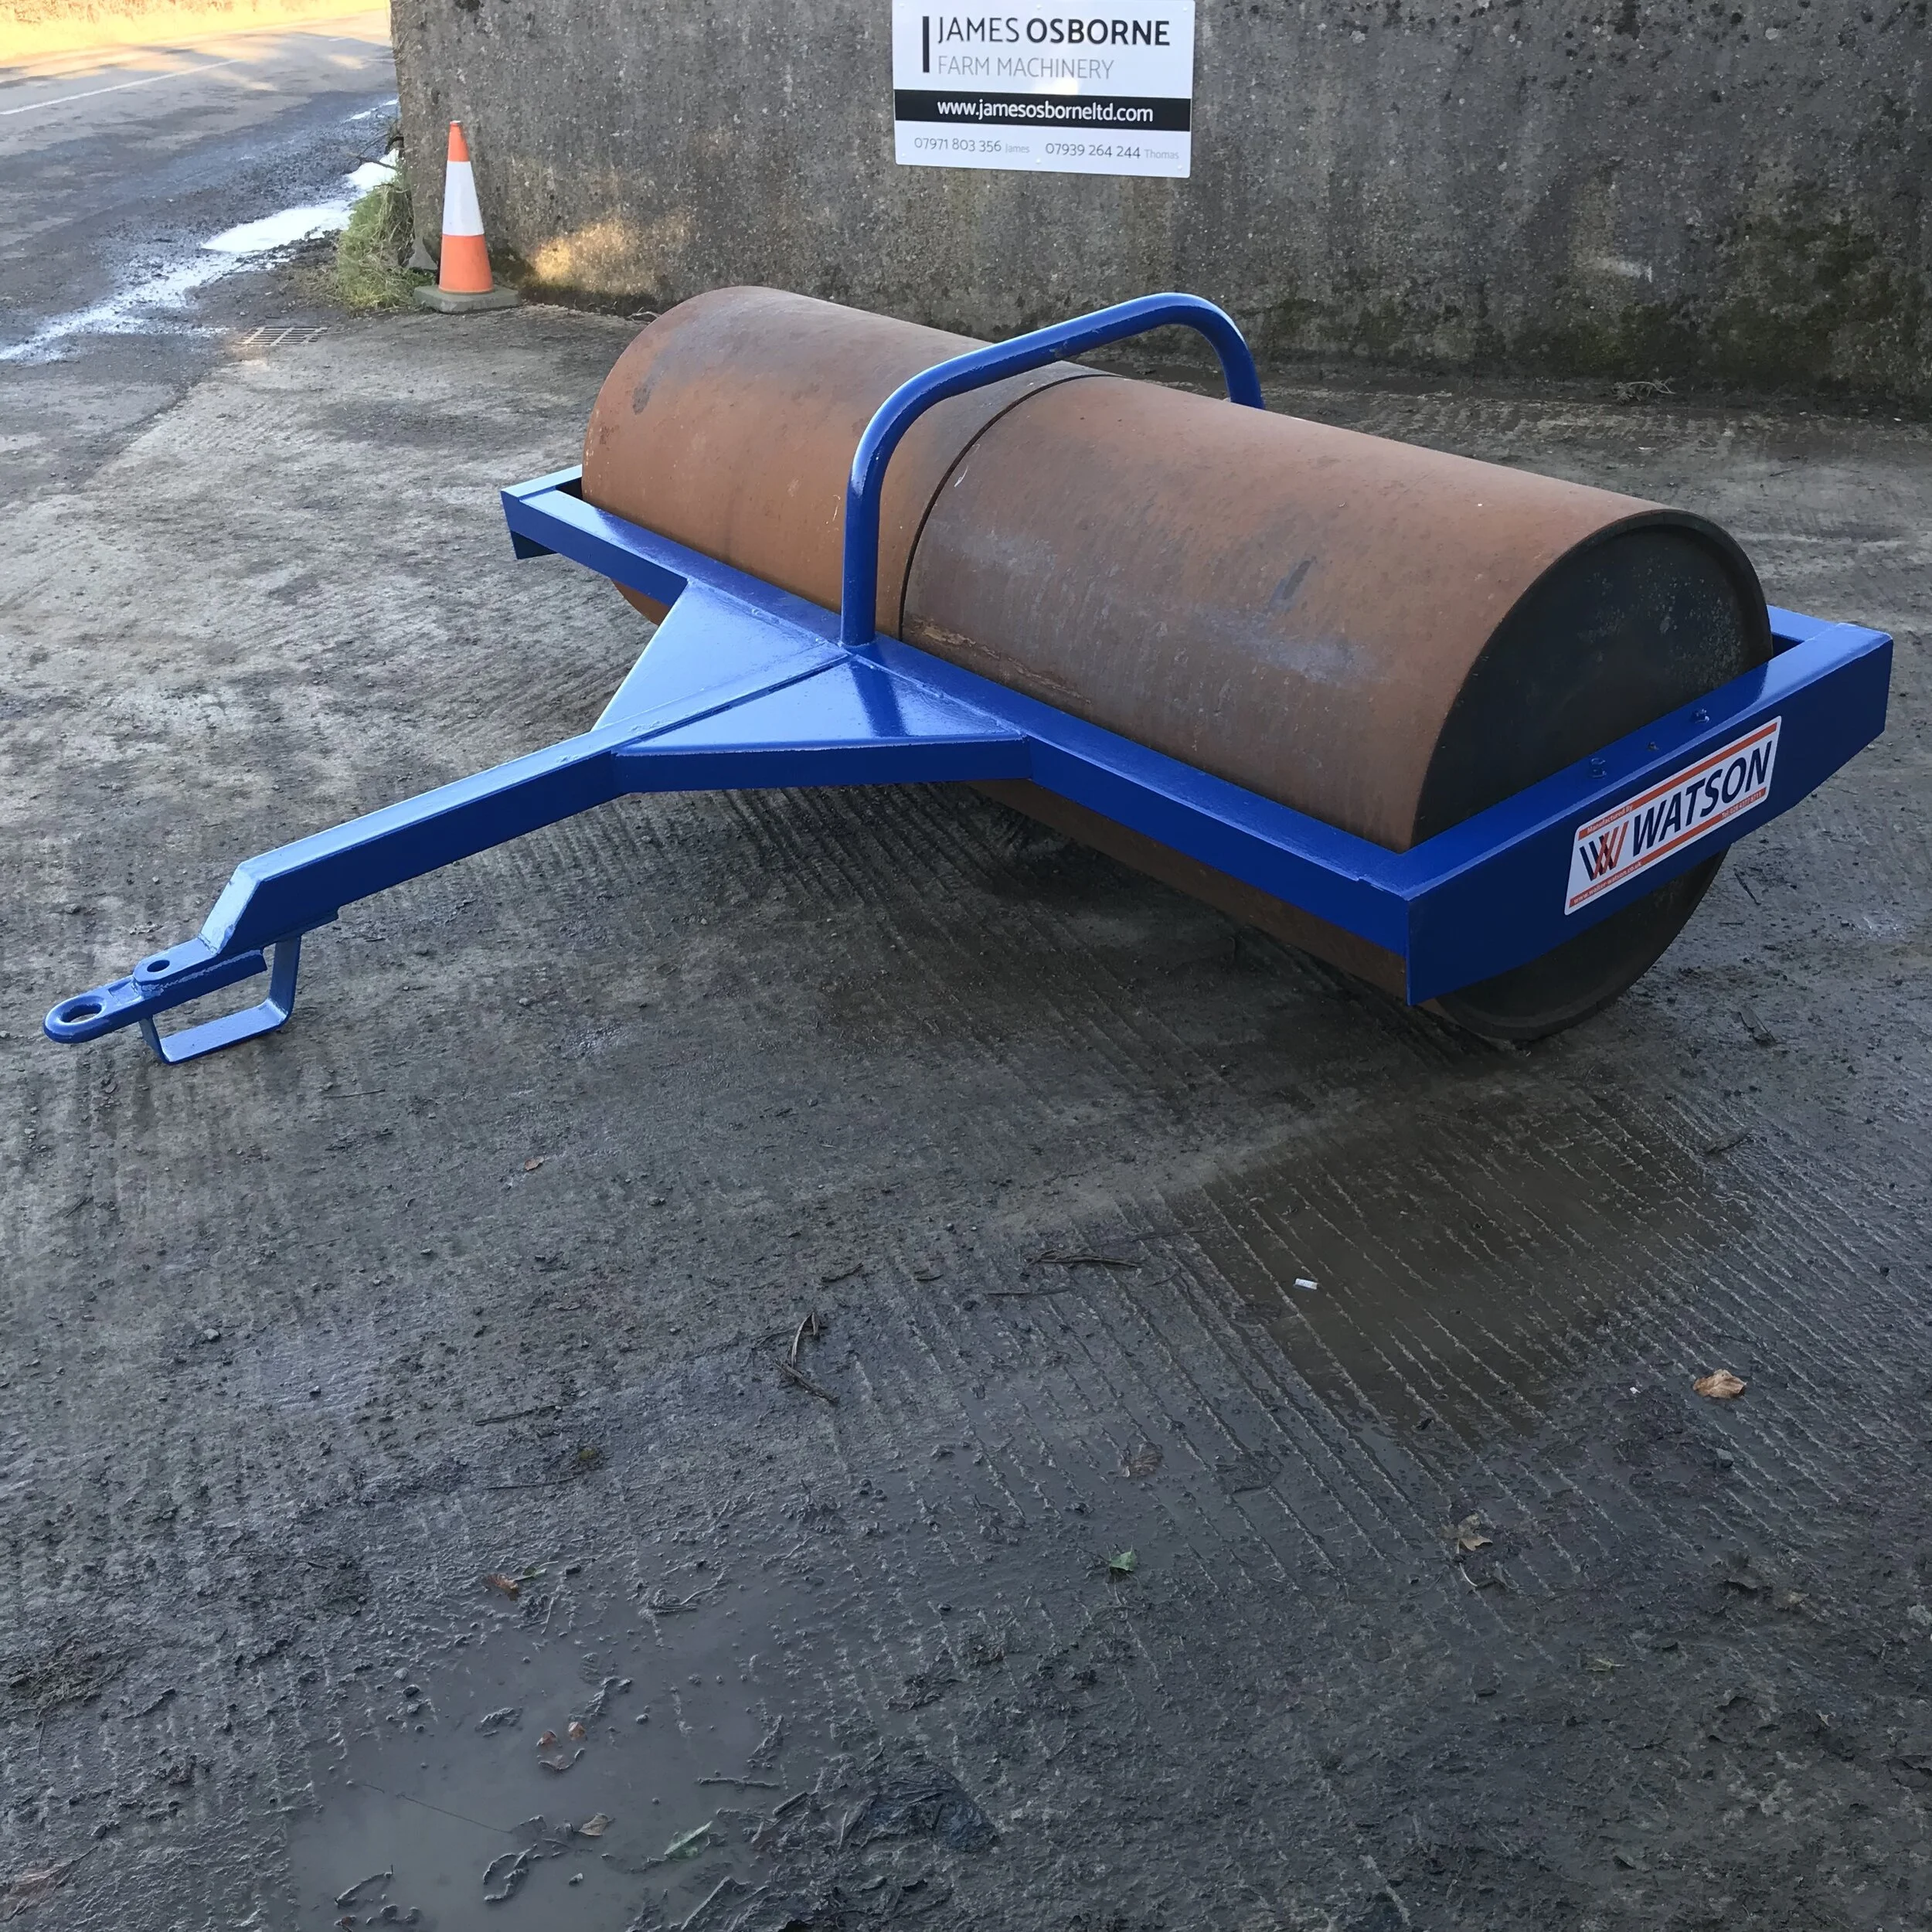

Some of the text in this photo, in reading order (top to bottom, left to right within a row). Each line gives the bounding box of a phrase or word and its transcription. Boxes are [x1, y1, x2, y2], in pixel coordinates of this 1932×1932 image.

[937, 16, 1171, 46] JAMES OSBORNE
[938, 56, 1114, 80] FARM MACHINERY
[937, 98, 1154, 122] www.jamesosborneltd.com
[914, 137, 1030, 154] 07971 803 356 James
[1046, 143, 1179, 159] 07939 264 244 Thomas
[1633, 740, 1773, 857] WATSON
